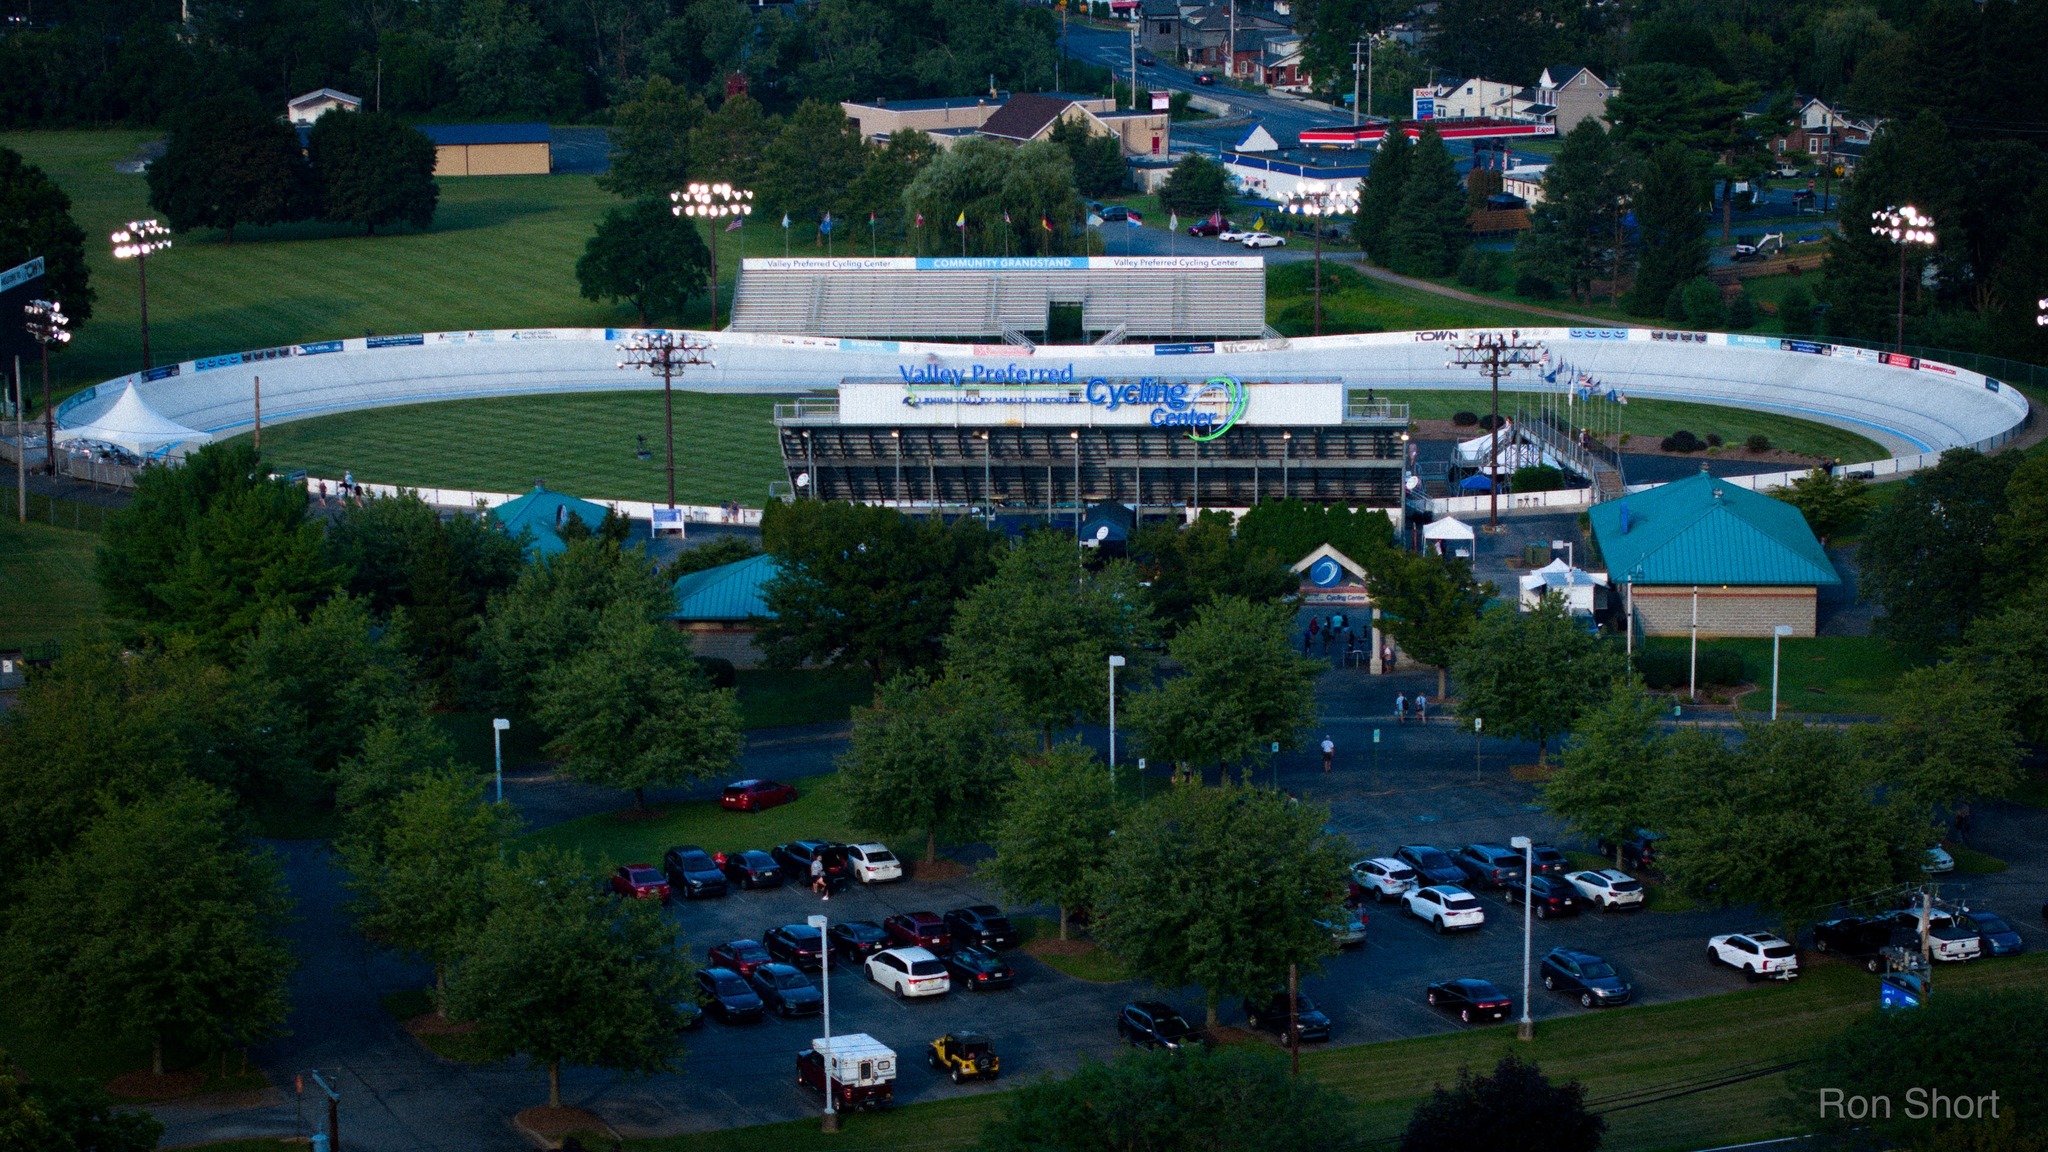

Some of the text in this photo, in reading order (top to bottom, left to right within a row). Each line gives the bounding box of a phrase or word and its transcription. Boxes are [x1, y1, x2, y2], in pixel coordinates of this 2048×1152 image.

[1415, 89, 1433, 97] Exxon
[1537, 126, 1554, 134] Exxon
[767, 260, 891, 269] Valley Preferred Cycling Center
[934, 259, 1071, 268] COMMUNITY GRANDSTAND
[1113, 258, 1238, 268] Valley Preferred Cycling Center
[899, 363, 1073, 387] Valley Preferred
[1086, 376, 1189, 410] Cycling
[1150, 407, 1217, 427] Center
[1326, 594, 1347, 602] Cycling
